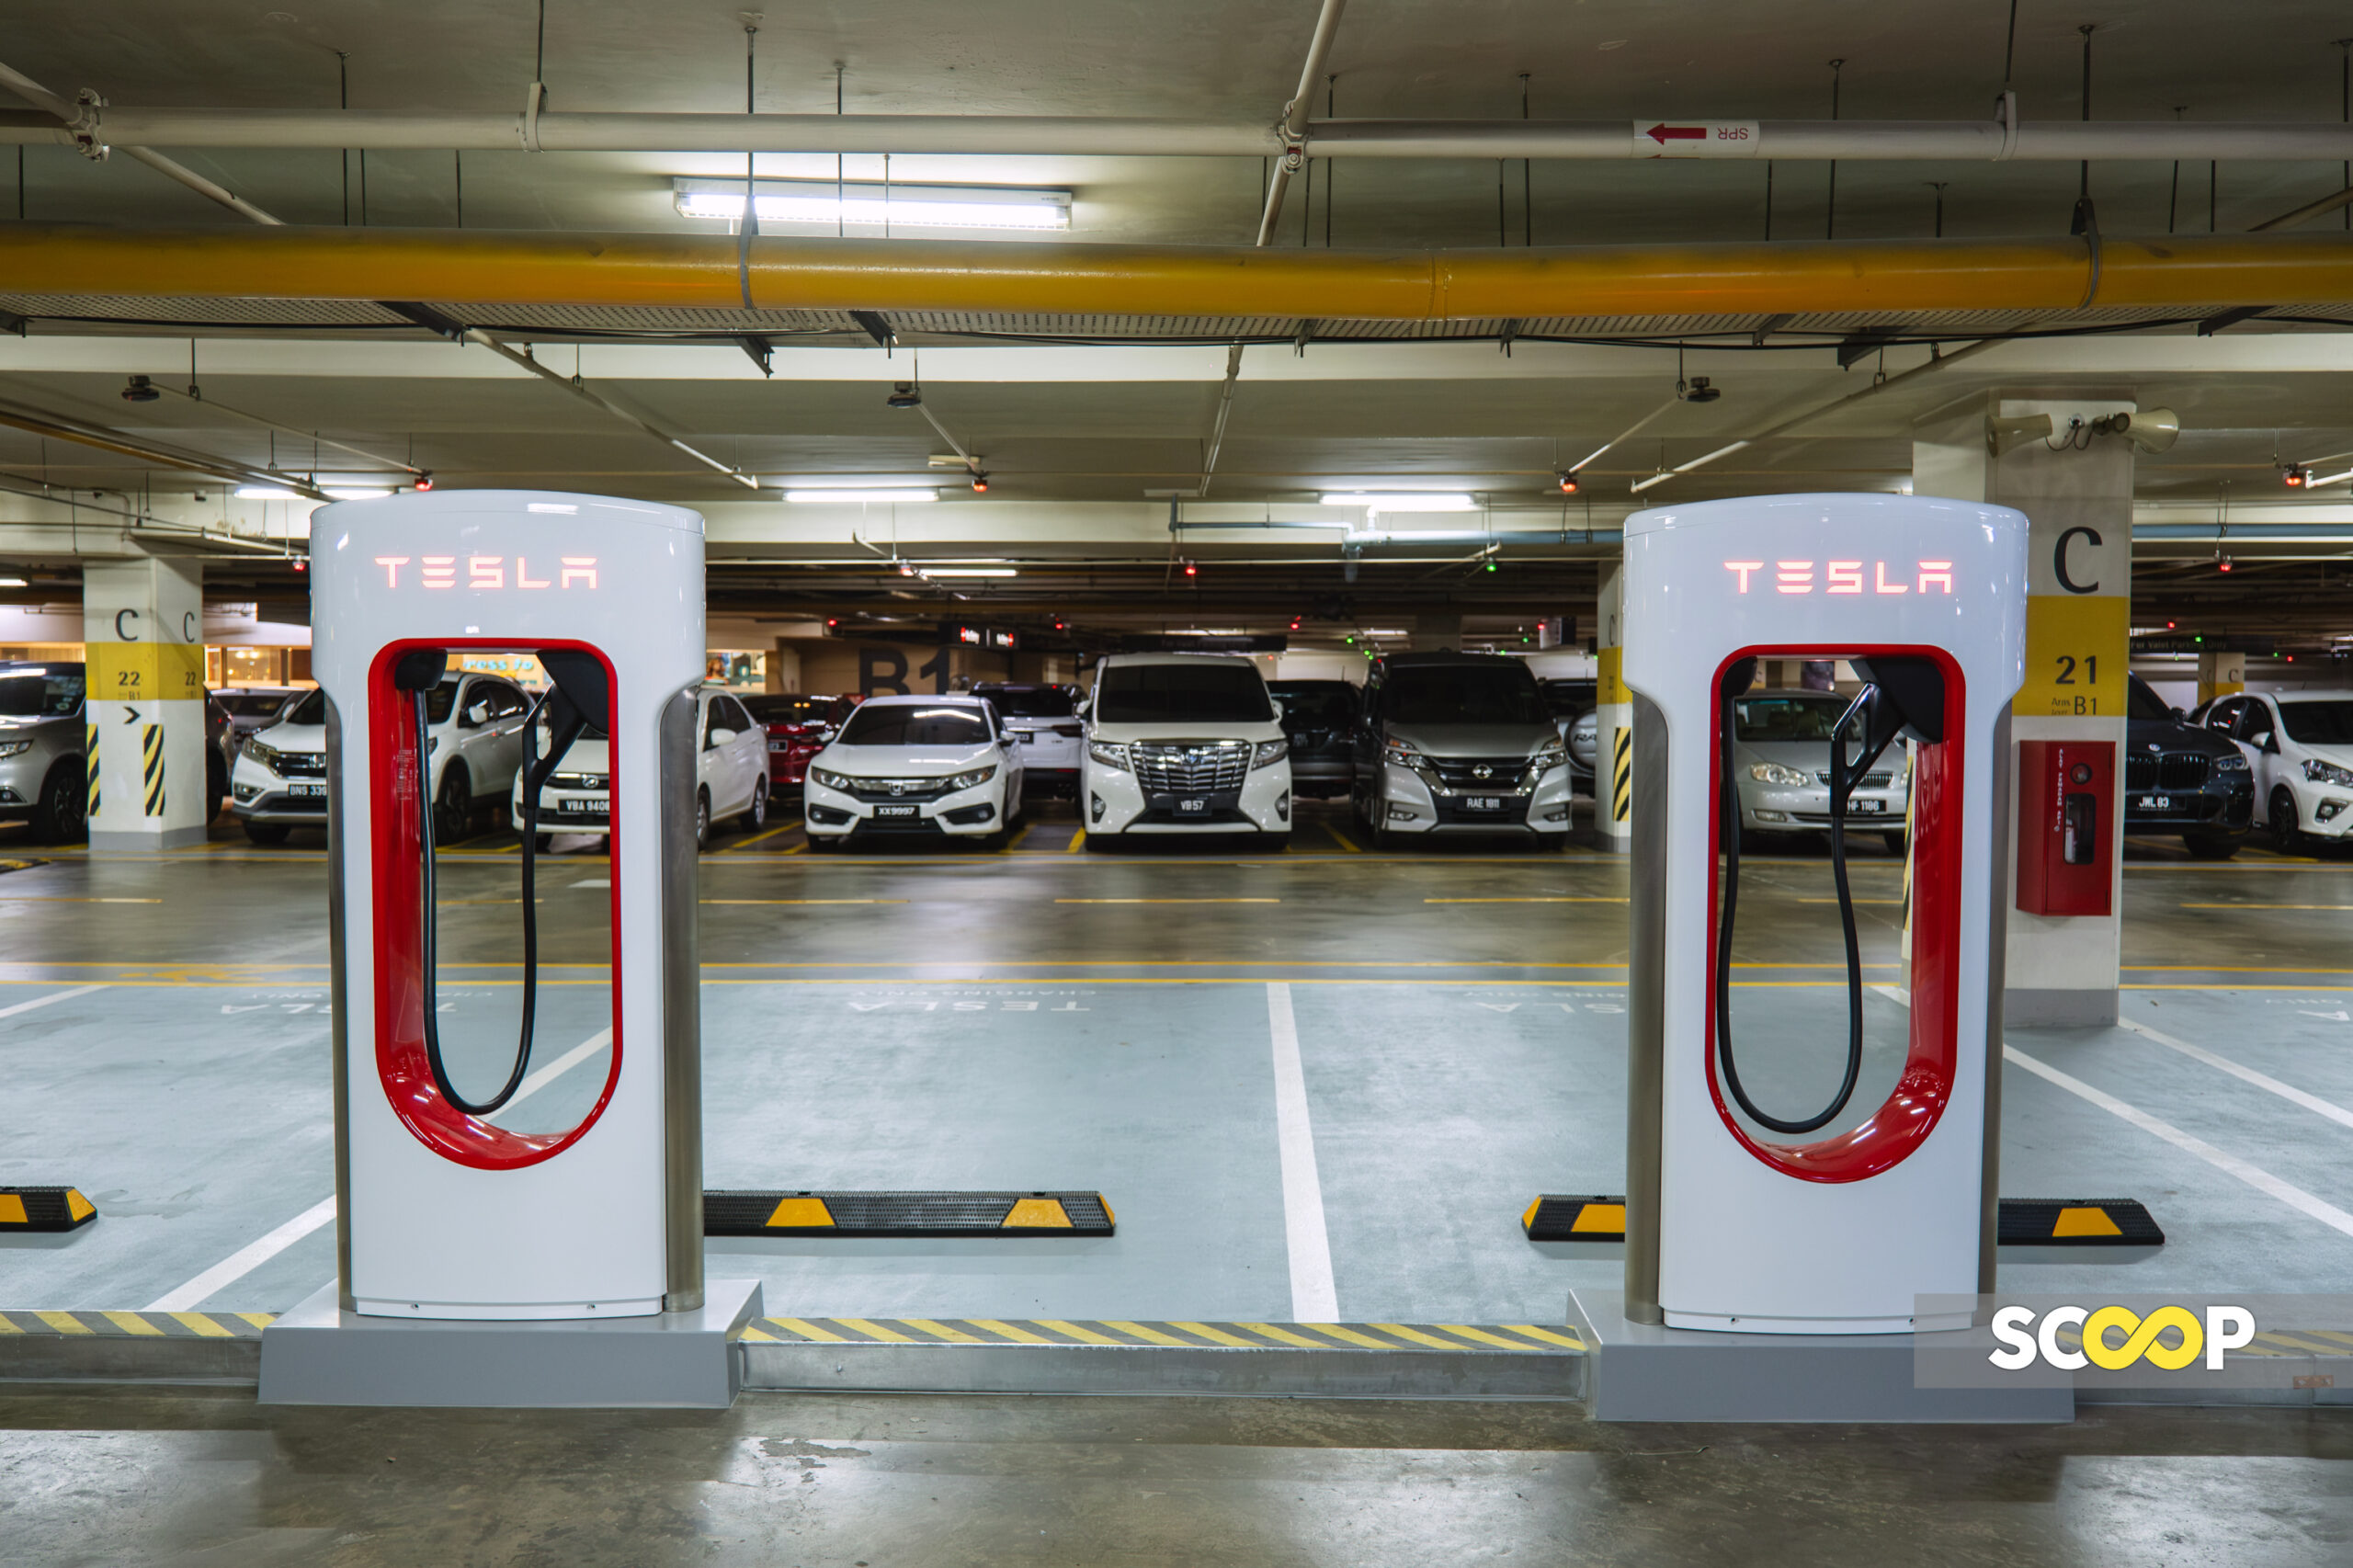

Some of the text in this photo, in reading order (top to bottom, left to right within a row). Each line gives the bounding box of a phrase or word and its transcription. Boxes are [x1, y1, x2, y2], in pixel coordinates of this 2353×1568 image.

[1717, 127, 1749, 141] SPR
[2053, 526, 2103, 595] C
[374, 556, 598, 590] TESLA
[1722, 561, 1953, 595] TESLA
[115, 608, 139, 642] C
[184, 611, 195, 643] C
[118, 671, 141, 687] 22
[2054, 654, 2097, 685] 21
[2074, 696, 2097, 716] B1
[566, 800, 585, 812] VBA
[1467, 798, 1484, 809] RAE
[2139, 796, 2156, 808] JWL
[847, 1000, 1091, 1012] TESLA
